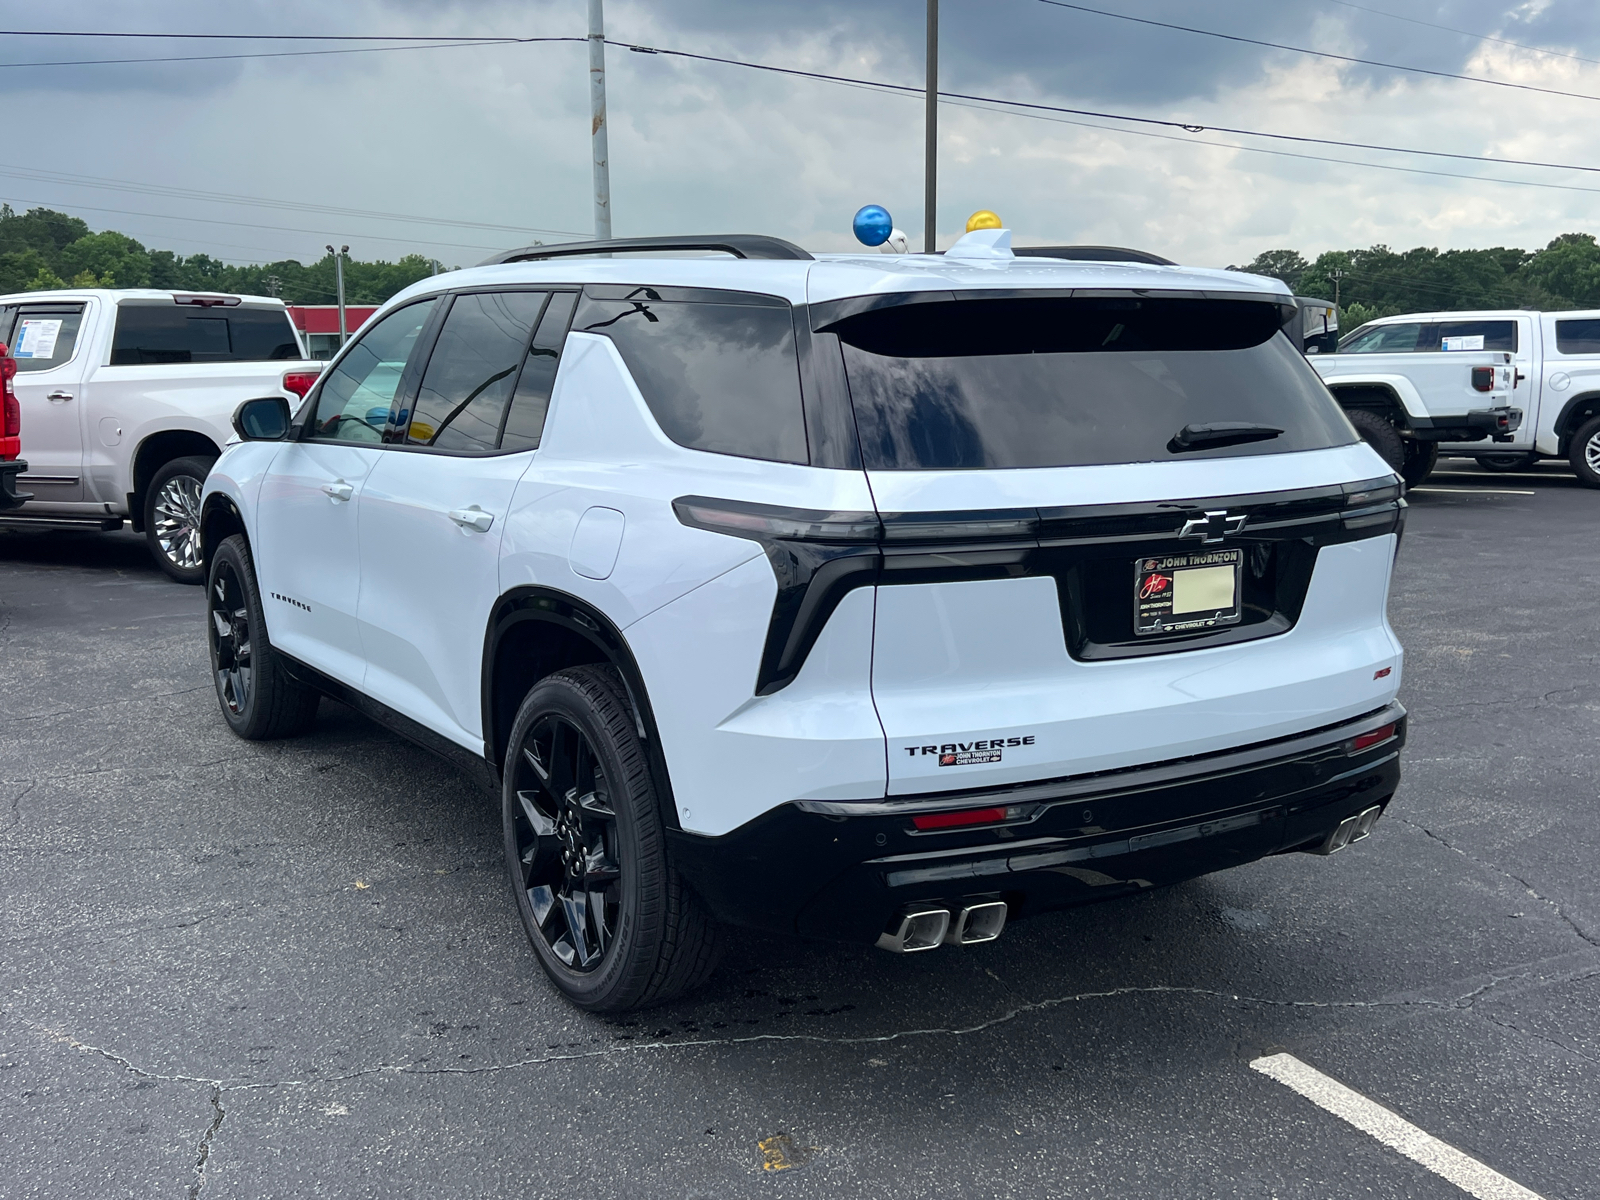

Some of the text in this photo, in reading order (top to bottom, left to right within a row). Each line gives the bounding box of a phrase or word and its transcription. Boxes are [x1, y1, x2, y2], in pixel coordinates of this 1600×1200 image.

[1161, 558, 1187, 568] JOHN
[1189, 552, 1237, 565] THORNTON
[270, 592, 312, 612] TRAVERSE
[1174, 622, 1206, 630] CHEVROLET
[904, 735, 1035, 756] TRAVERSE
[972, 749, 1000, 757] THORNTON
[956, 757, 990, 765] CHEVROLET
